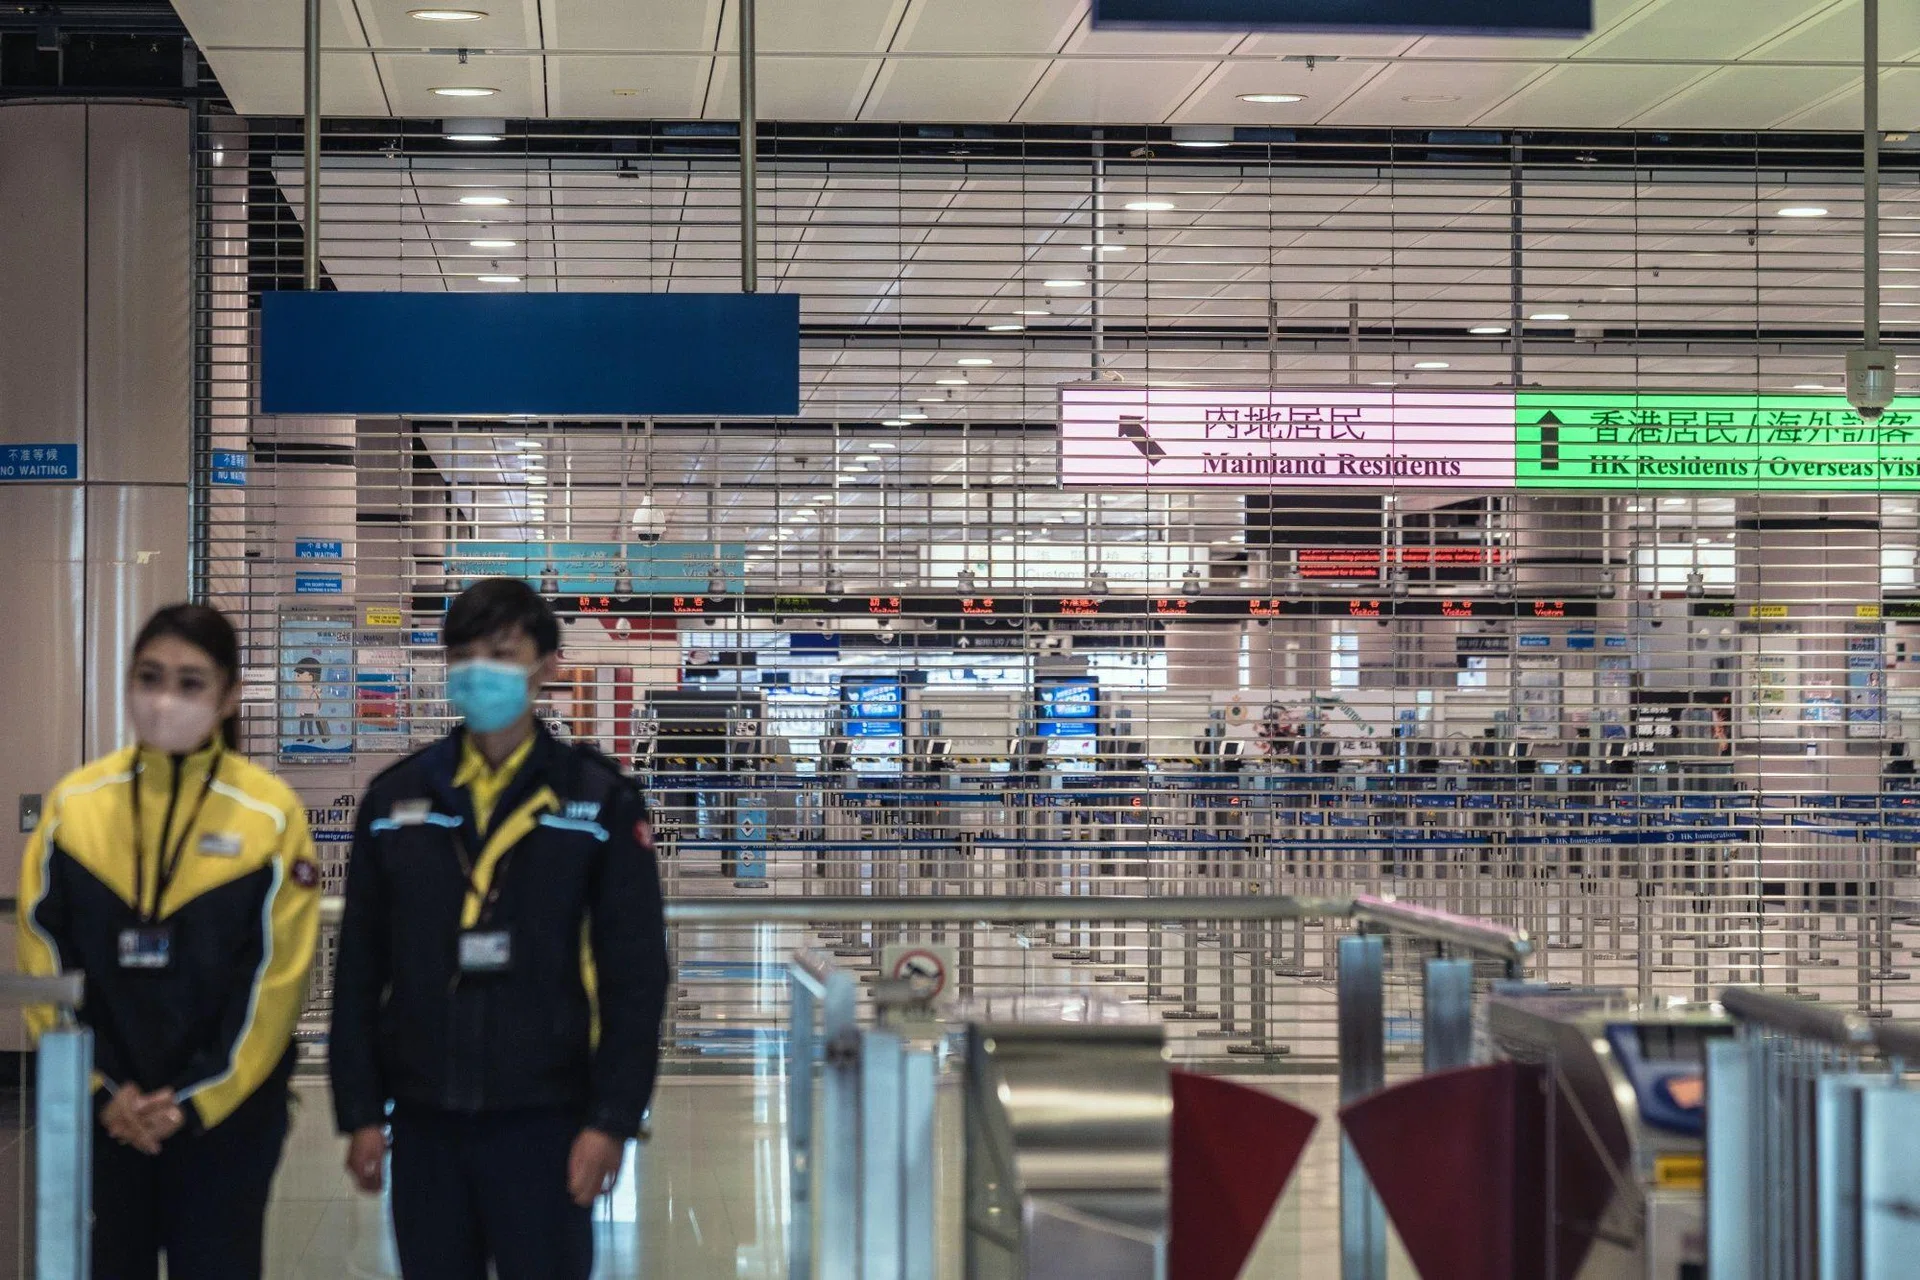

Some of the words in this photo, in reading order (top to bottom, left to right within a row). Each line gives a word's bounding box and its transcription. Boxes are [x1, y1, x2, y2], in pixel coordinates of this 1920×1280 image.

[1204, 406, 1366, 440] 內地居民
[8, 448, 58, 461] 不准等候
[0, 465, 15, 476] NO
[20, 464, 68, 476] WAITING
[1202, 452, 1326, 475] Mainland
[1336, 453, 1461, 477] Residents
[1590, 454, 1631, 476] HK
[1638, 454, 1749, 476] Residents
[1769, 455, 1875, 477] Overseas
[1249, 608, 1280, 616] Visitors
[1350, 608, 1380, 616] Visitors
[1569, 836, 1612, 845] Immigration
[1681, 832, 1693, 840] HK
[1695, 831, 1737, 840] Immigration
